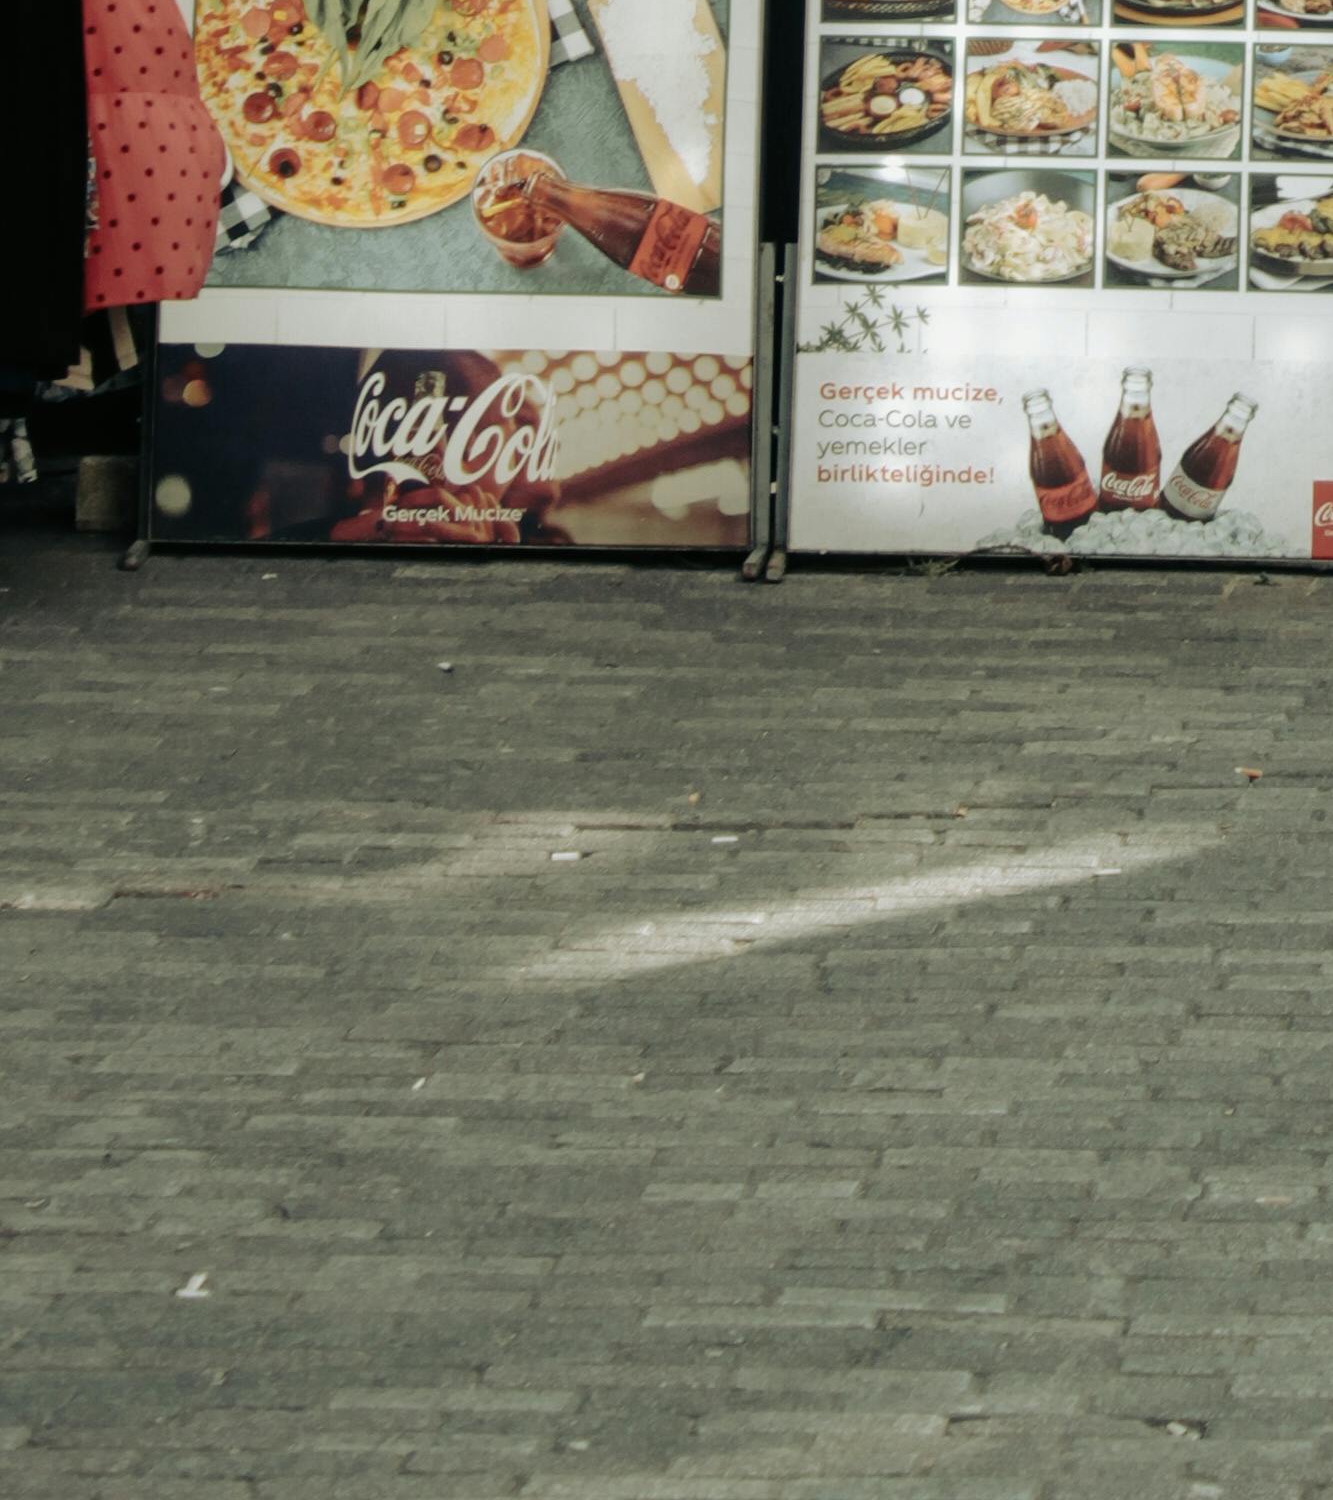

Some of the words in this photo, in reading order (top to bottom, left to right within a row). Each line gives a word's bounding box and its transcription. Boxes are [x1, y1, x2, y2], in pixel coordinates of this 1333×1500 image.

[819, 382, 905, 405] Gerçek
[912, 382, 1004, 405] mucize,
[817, 409, 939, 429] Coca-Cola
[944, 414, 973, 429] ve
[816, 437, 928, 459] yemekler
[816, 464, 995, 488] birlikteliğinde!
[381, 504, 450, 526] Gerçek
[454, 506, 524, 523] Mucize
